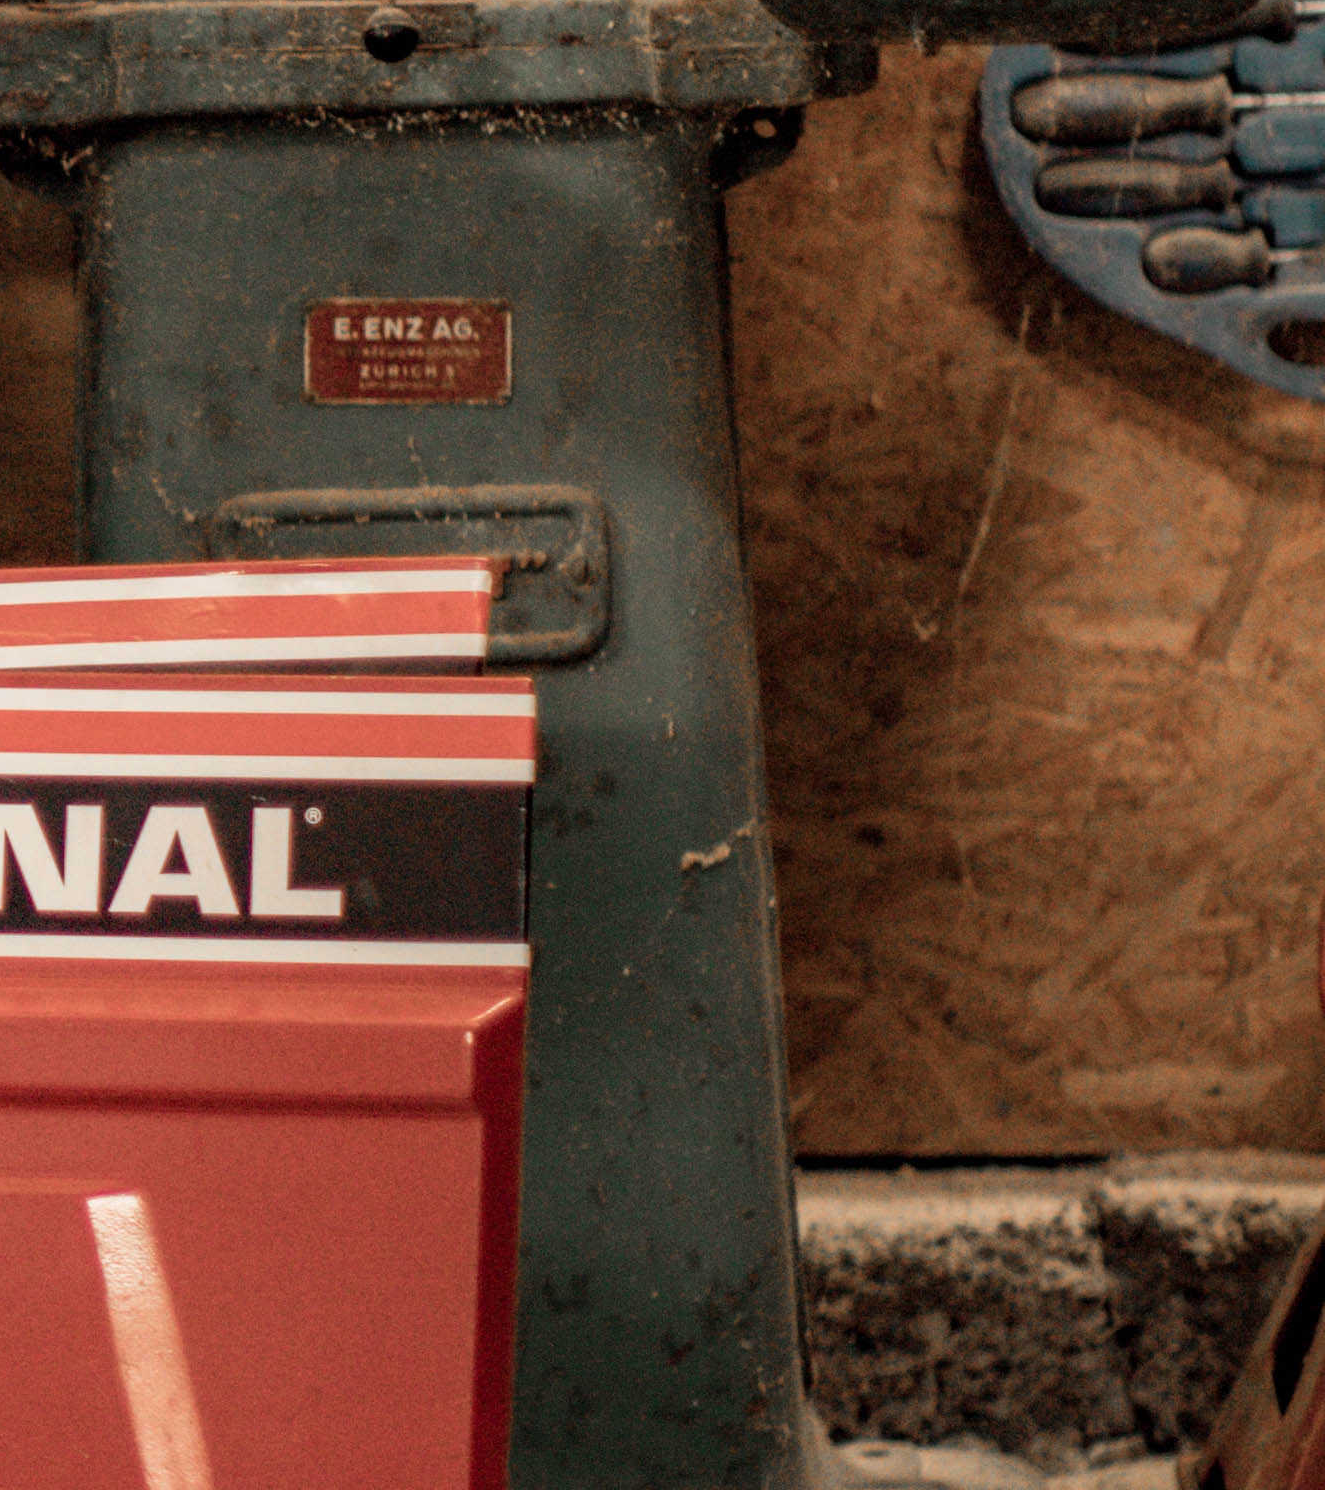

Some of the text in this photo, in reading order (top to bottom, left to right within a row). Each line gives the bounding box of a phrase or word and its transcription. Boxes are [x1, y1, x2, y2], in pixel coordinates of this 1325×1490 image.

[333, 316, 481, 343] E. ENZ AG.
